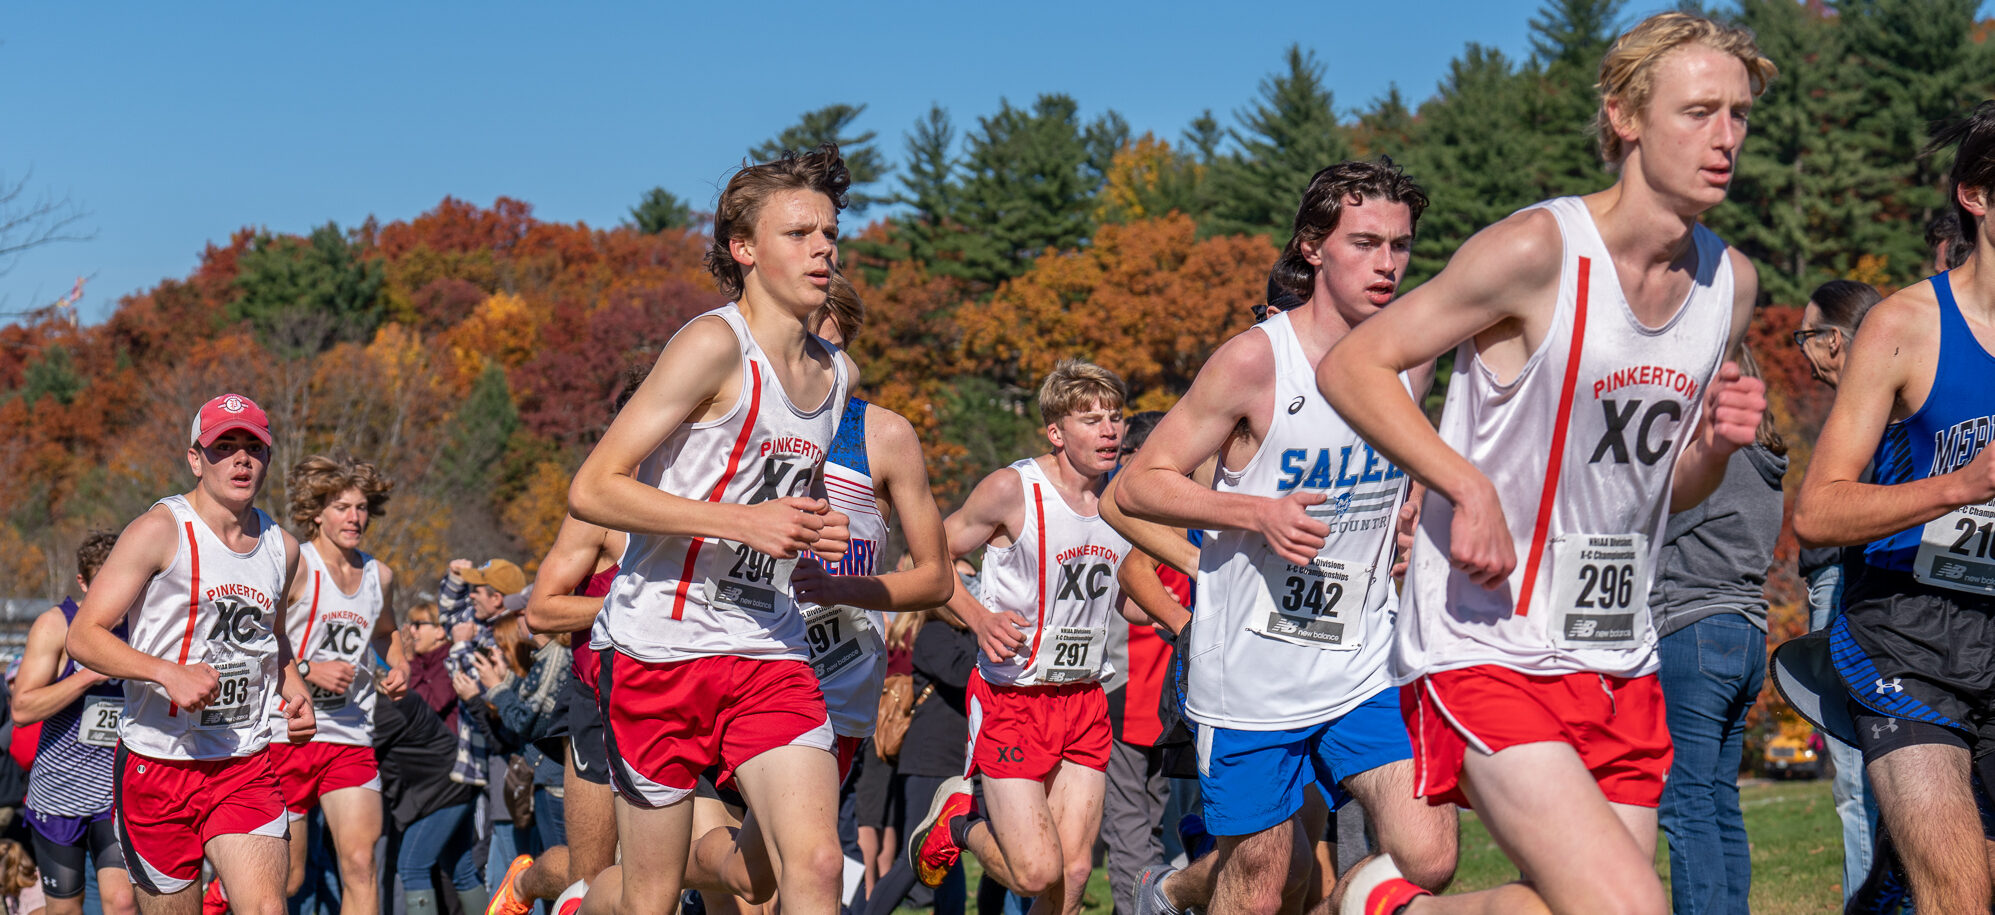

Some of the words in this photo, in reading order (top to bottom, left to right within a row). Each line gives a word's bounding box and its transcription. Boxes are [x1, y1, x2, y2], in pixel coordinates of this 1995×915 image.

[1593, 365, 1698, 400] PINKERTON
[1588, 399, 1682, 466] XC
[1928, 415, 1995, 478] MER
[1954, 505, 1969, 514] -C
[1968, 507, 1995, 519] Champ
[1329, 515, 1391, 534] COUNTR
[1949, 518, 1995, 561] 21
[728, 543, 777, 585] 294
[1056, 545, 1119, 565] PINKERTON
[1316, 558, 1345, 570] Divisions
[1057, 563, 1112, 600] XC
[1286, 564, 1298, 573] X-C
[1299, 566, 1349, 581] Championships
[1964, 575, 1981, 583] new
[1575, 564, 1634, 609] 296
[206, 583, 273, 611] PINKERTON
[740, 597, 752, 605] new
[753, 600, 772, 609] balance
[1282, 576, 1343, 618] 342
[207, 601, 262, 644] XC
[322, 610, 368, 629] PINKERTON
[319, 623, 361, 655] XC
[1297, 629, 1313, 637] new
[1313, 632, 1339, 641] balance
[1610, 629, 1632, 638] balance
[837, 649, 859, 666] balance
[1054, 642, 1089, 667] 297
[96, 709, 120, 728] 25
[997, 746, 1025, 762] XC
